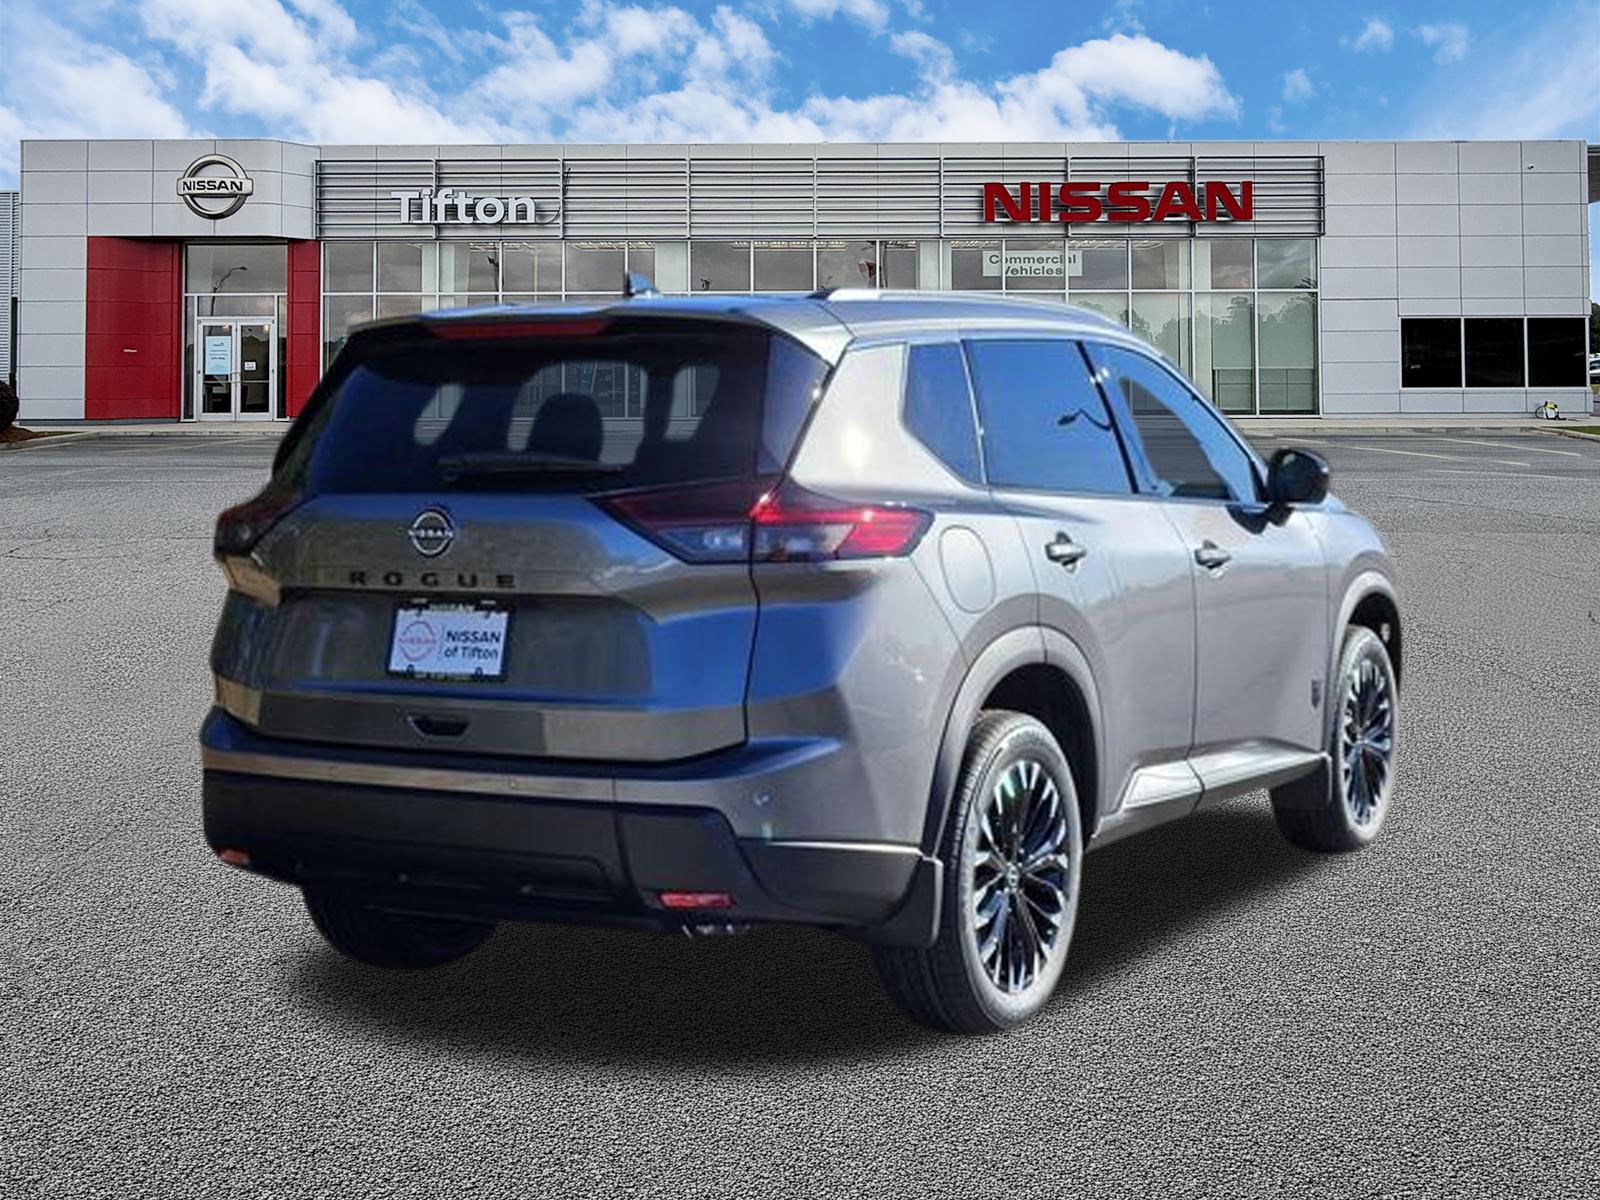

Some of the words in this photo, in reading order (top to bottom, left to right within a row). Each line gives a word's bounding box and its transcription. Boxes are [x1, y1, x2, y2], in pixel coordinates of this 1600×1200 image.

[182, 180, 243, 191] NISSAN
[390, 188, 536, 224] Tifton
[983, 180, 1254, 223] NISSAN
[350, 571, 516, 588] ROGUE
[445, 630, 500, 642] NISSAN
[443, 645, 459, 659] of
[461, 646, 498, 660] Tifton
